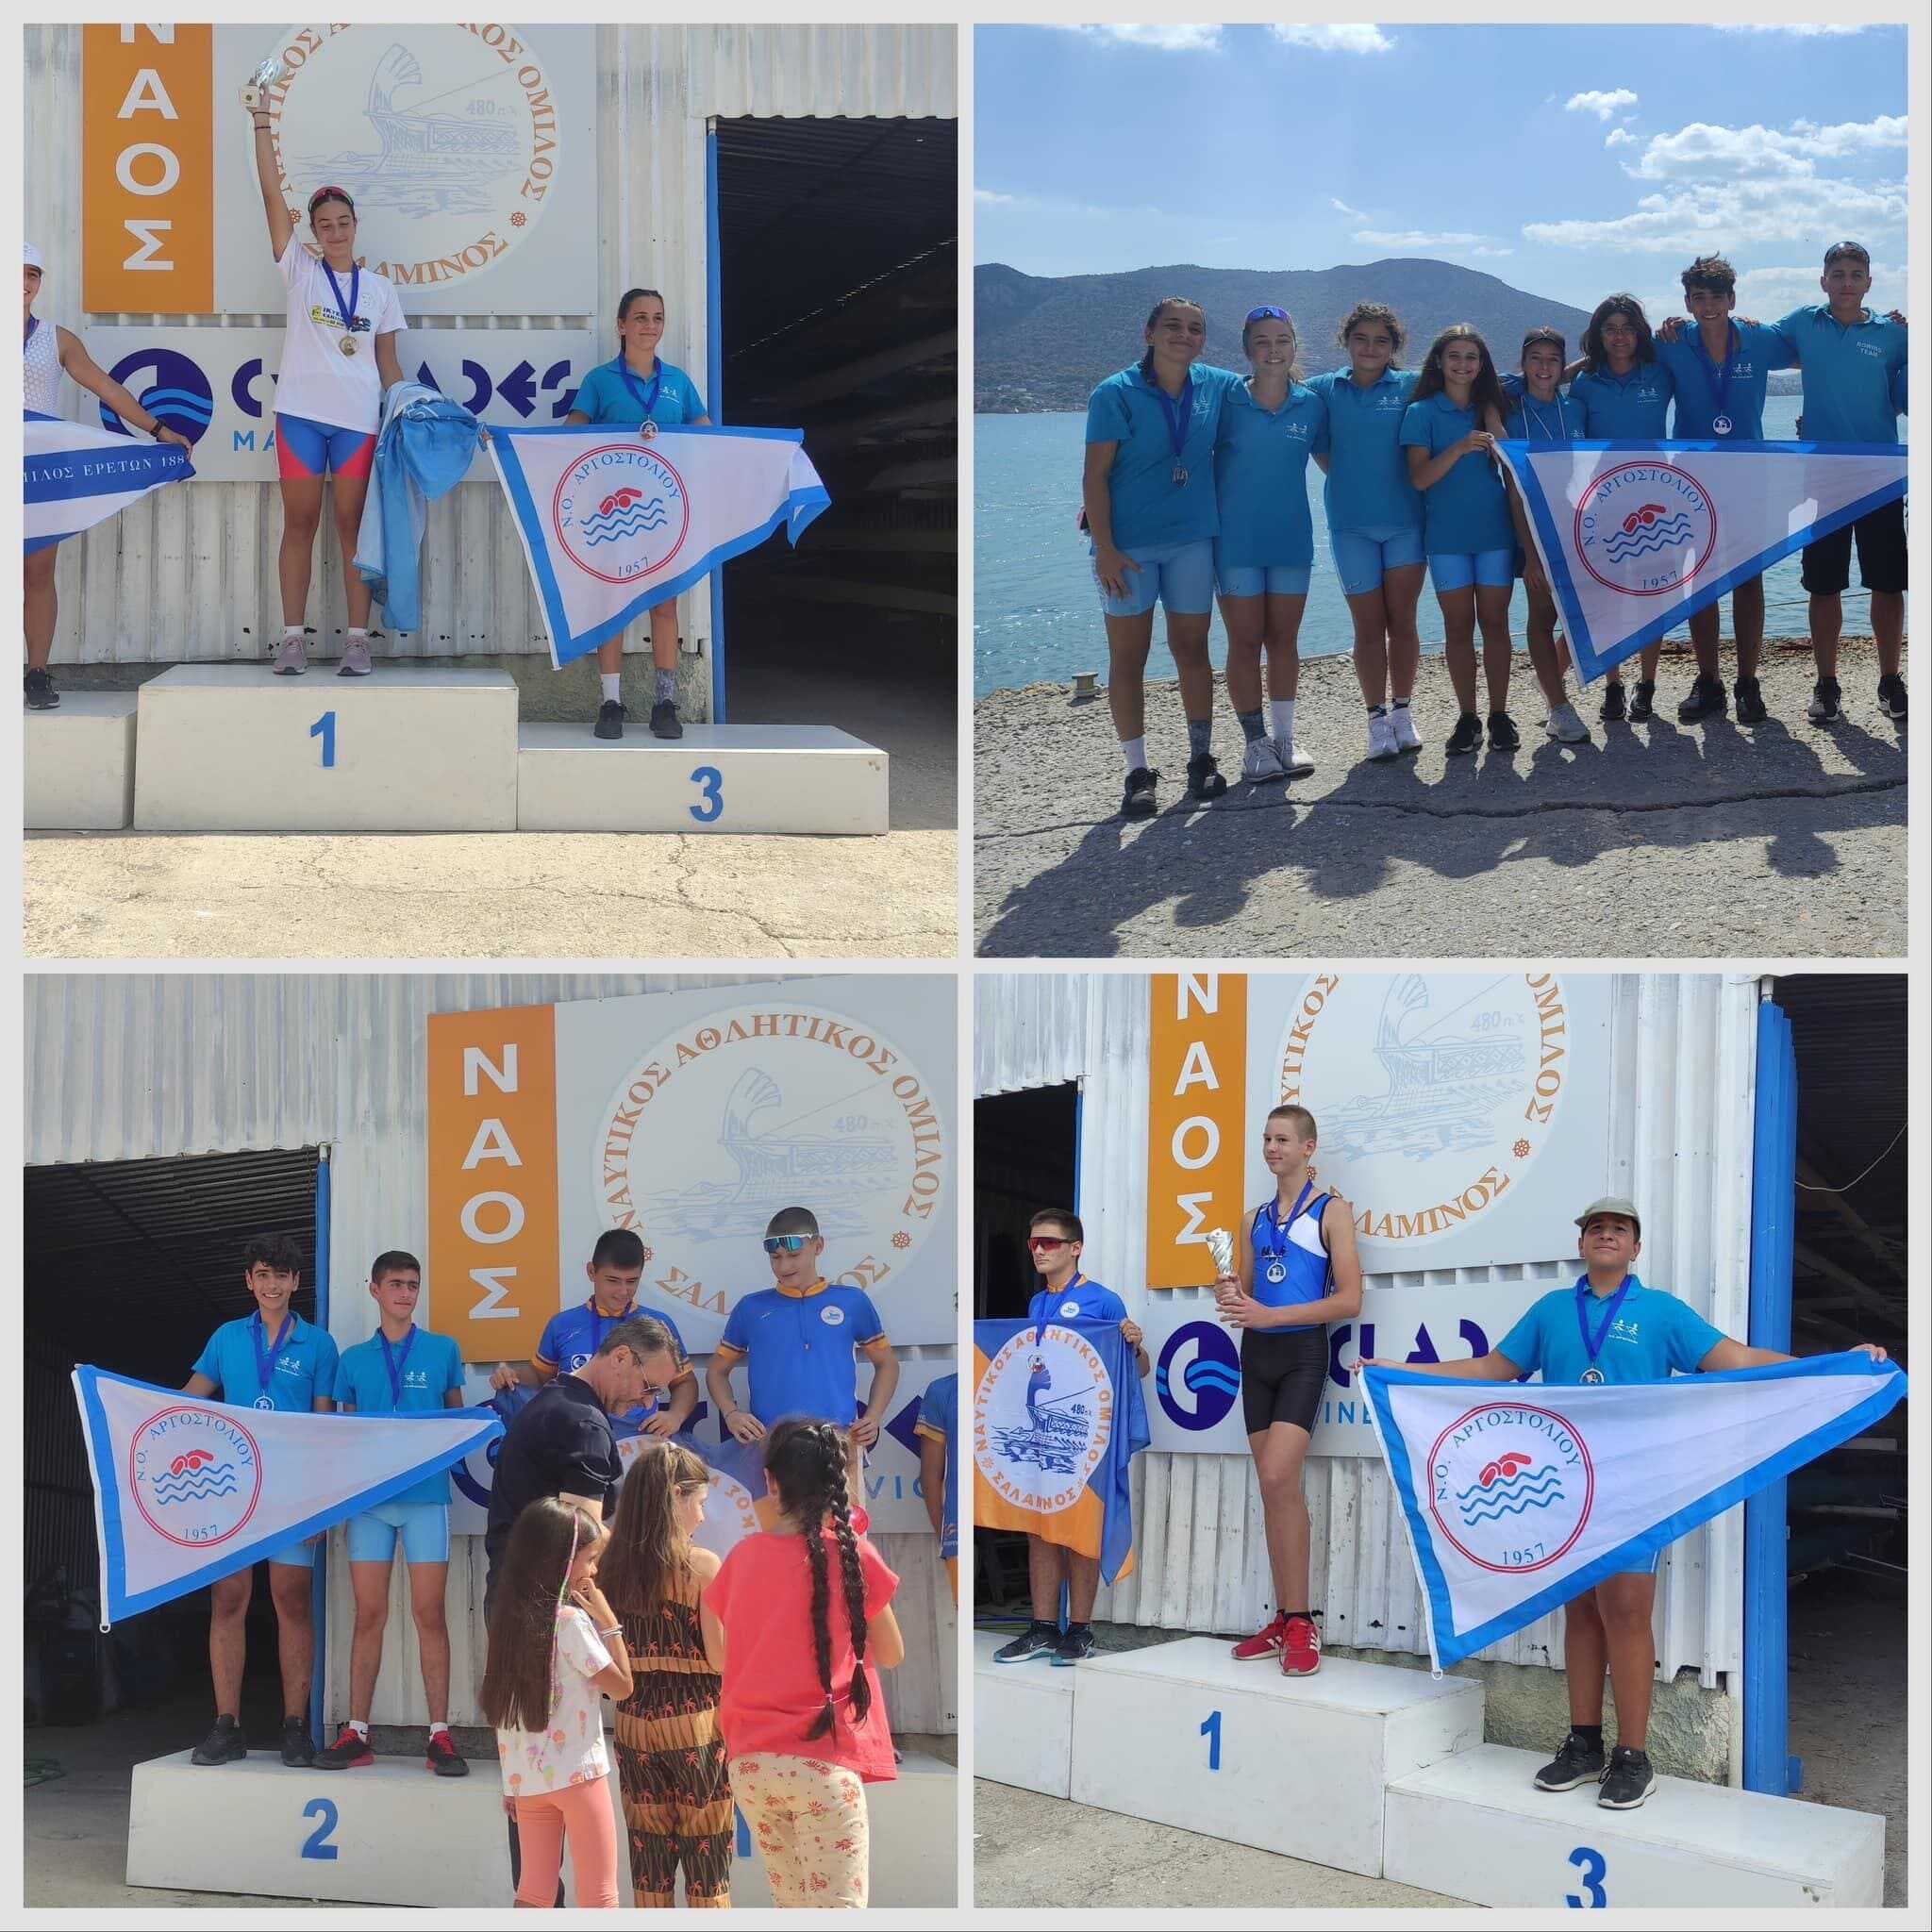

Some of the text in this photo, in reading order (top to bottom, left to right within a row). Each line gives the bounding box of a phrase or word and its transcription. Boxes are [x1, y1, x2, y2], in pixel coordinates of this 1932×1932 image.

[517, 64, 557, 203] ΟΜΙΛΟΣ
[83, 458, 153, 477] ΕΡΕΤΩΝ
[161, 454, 186, 469] 188
[574, 452, 680, 500] ΑΡΓΟΣΤΟΛΙΟΥ
[1596, 469, 1707, 514] ΑΡΓΟΣΤΟΛΙΟΥ
[617, 556, 650, 578] 1957
[1641, 570, 1679, 590] 1957
[309, 710, 338, 767] 1
[688, 766, 724, 823] 3
[1281, 974, 1340, 1106] ΥΤΙΚΟΣ
[604, 1013, 942, 1235] ΝΑΥΤΙΚΟΣ ΑΘΛΗΤΙΚΟΣ ΟΜΙΛΟΣ
[460, 1043, 525, 1321] ΝΑΟΣ
[1330, 1168, 1510, 1239] ΛΑΜΙΝΟΣ
[974, 1348, 1012, 1453] ΝΑΥΤΙΚΟΣ
[149, 1413, 255, 1467] ΑΡΓΟΣΤΟΛΙΟΥ
[1452, 1410, 1582, 1466] ΑΡΓΟΣΤΟΛΙΟΥ
[183, 1524, 219, 1541] 1957
[1502, 1541, 1547, 1566] 1957
[1200, 1709, 1223, 1771] 1
[302, 1798, 340, 1860] 2
[1565, 1846, 1608, 1908] 3
